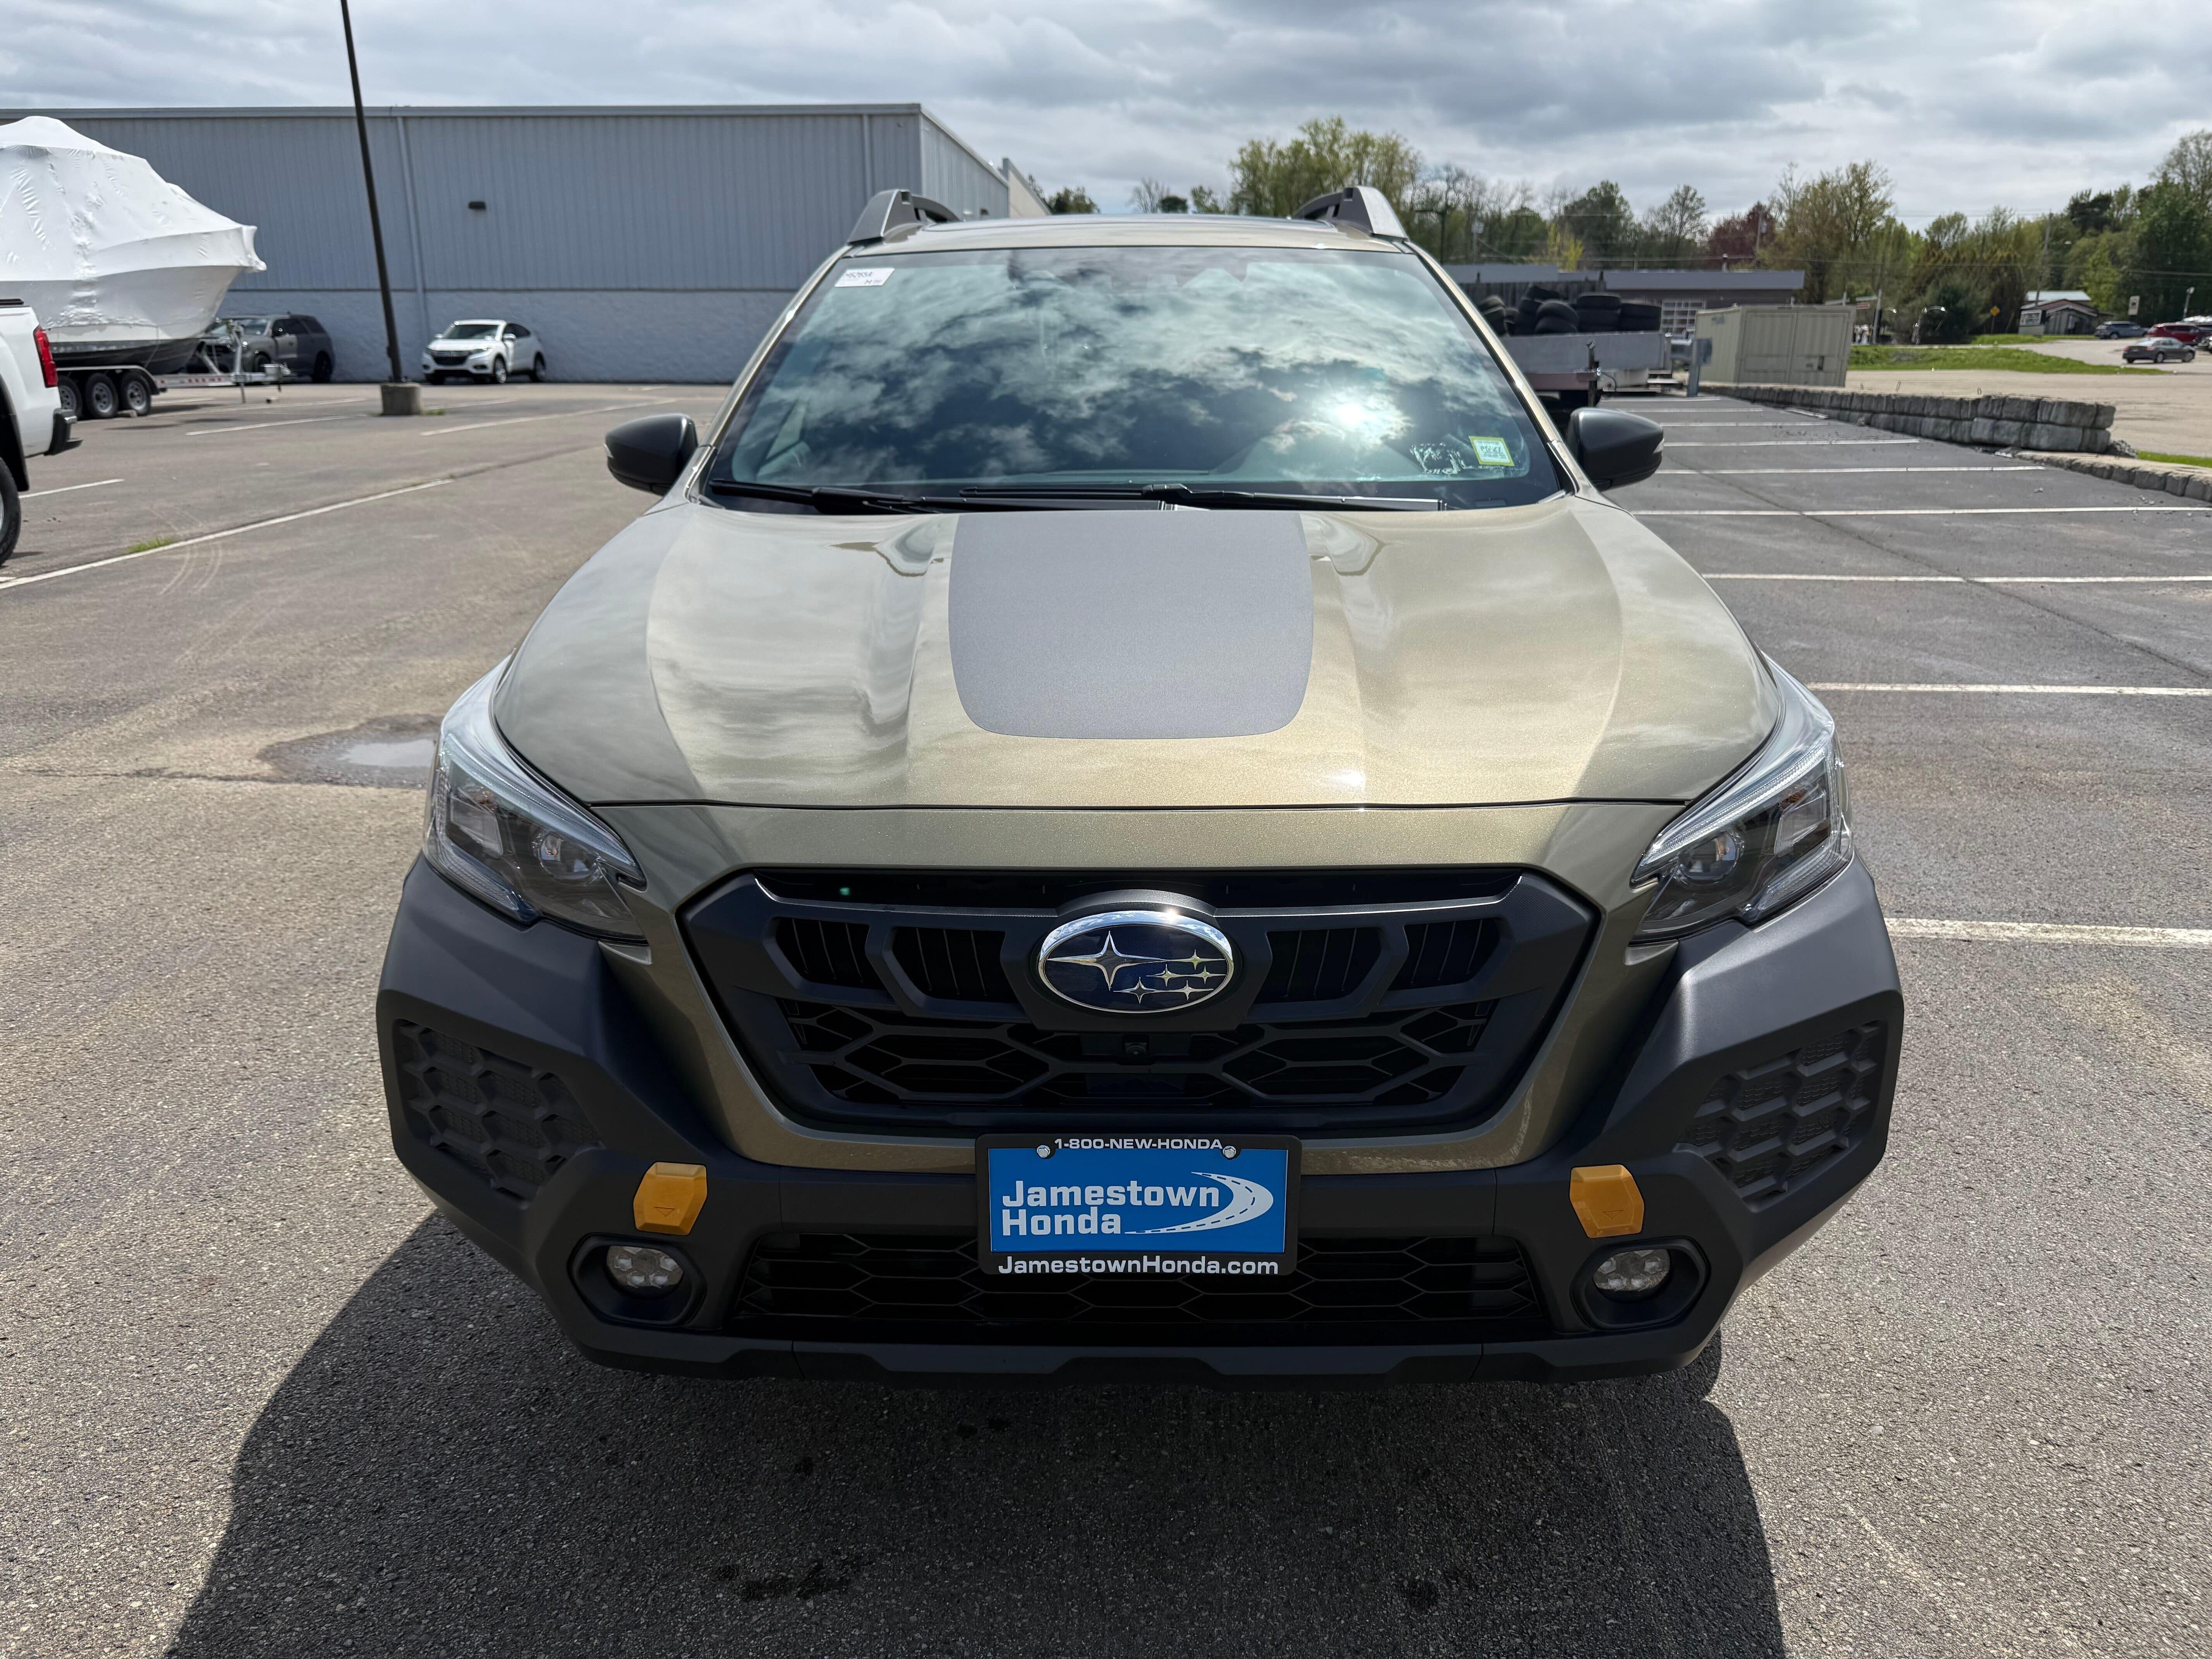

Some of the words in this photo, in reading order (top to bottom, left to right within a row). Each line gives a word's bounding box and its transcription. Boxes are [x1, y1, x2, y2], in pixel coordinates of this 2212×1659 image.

[1054, 1138, 1223, 1149] 1-800-NEW-HONDA
[1002, 1180, 1219, 1207] Jamestown
[1002, 1206, 1121, 1236] Honda
[998, 1255, 1279, 1274] JamestownHonda.com
